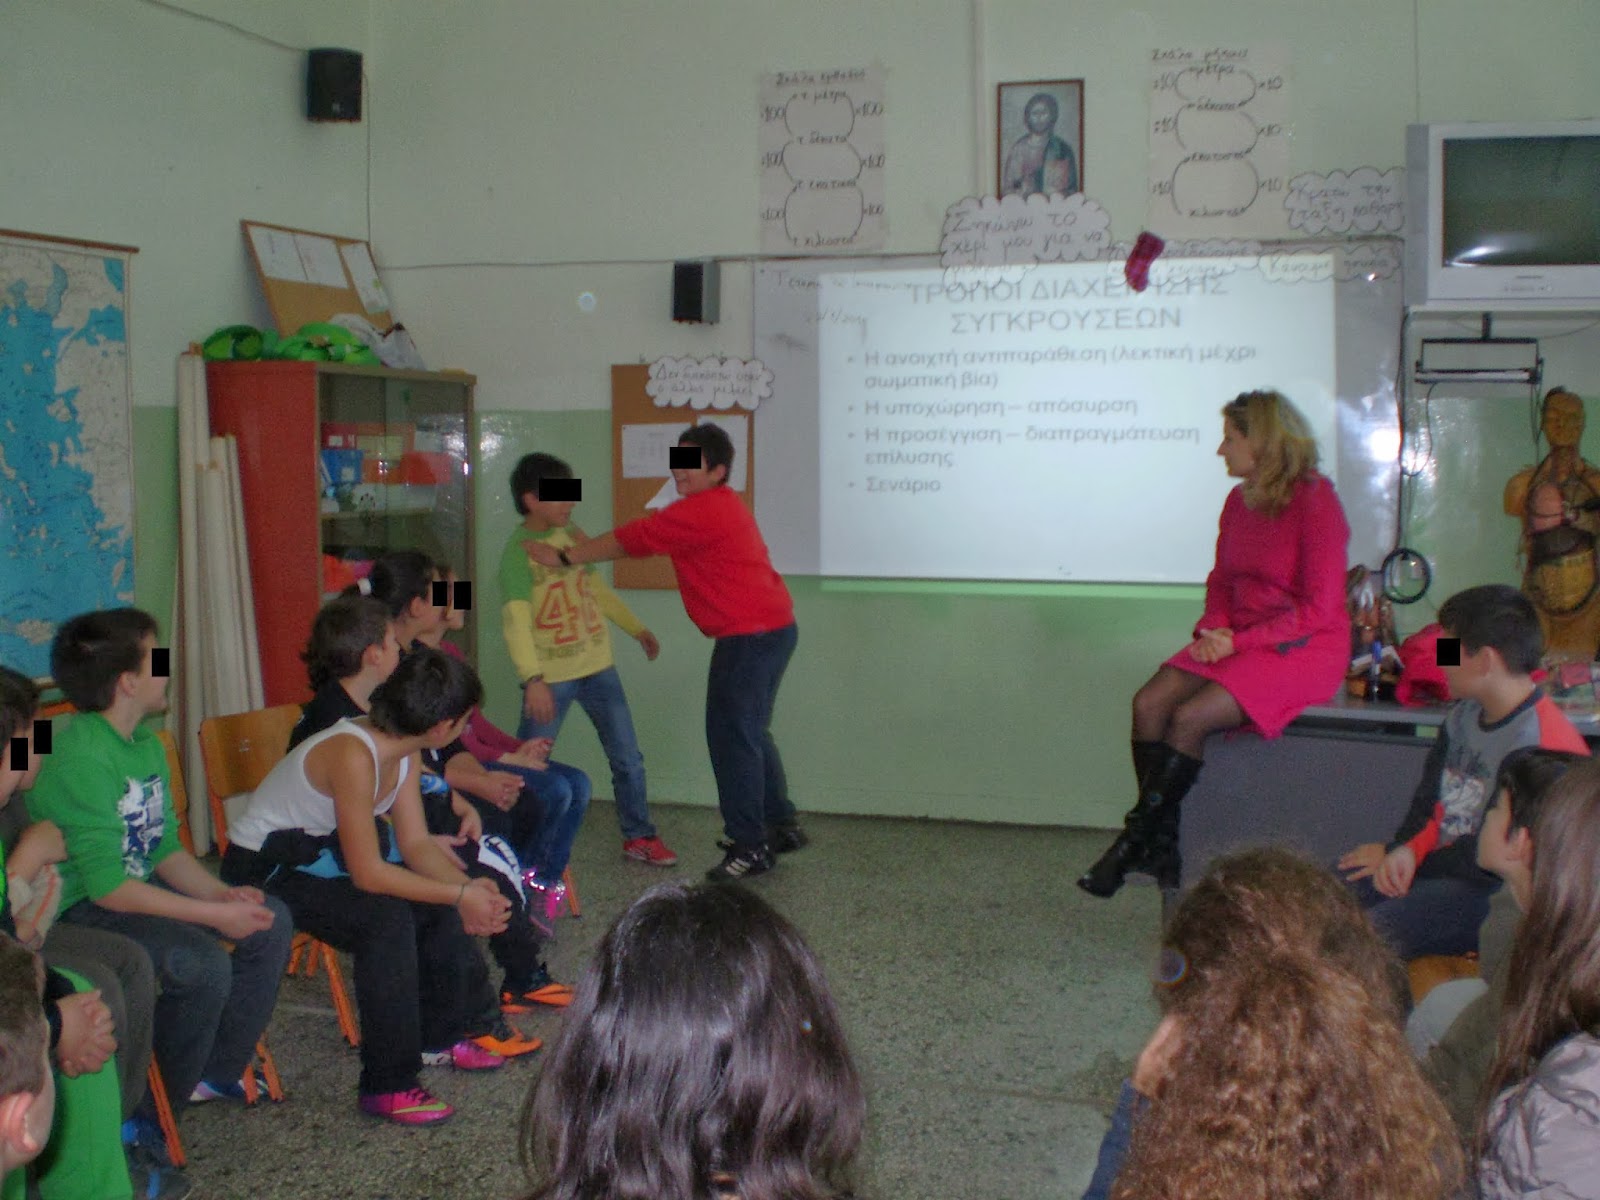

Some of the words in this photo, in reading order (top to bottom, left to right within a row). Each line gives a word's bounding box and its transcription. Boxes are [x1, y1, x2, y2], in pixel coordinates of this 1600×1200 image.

[1048, 211, 1078, 227] το
[1002, 238, 1033, 262] μου
[1043, 233, 1072, 253] για
[1084, 231, 1103, 243] να
[909, 281, 1022, 304] ΤΡΟΠΟΙ
[952, 307, 1180, 333] ΣΥΓΚΡΟΥΣΕΩΝ
[865, 352, 879, 366] Η
[885, 349, 958, 368] ανοιχτή
[963, 346, 1107, 365] αντιπαράθεση
[1111, 344, 1193, 363] (λεκτική
[1200, 345, 1256, 362] μέχρι
[865, 372, 957, 391] σωματική
[960, 371, 998, 391] βία)
[865, 402, 880, 416] Η
[885, 400, 1005, 418] υποχώρηση
[1028, 399, 1138, 416] απόσυρση
[865, 427, 880, 442] Η
[887, 425, 1002, 445] προσέγγιση
[1025, 424, 1201, 445] διαπραγμάτευση
[865, 449, 954, 469] επίλυσης
[866, 476, 942, 496] Σενάριο
